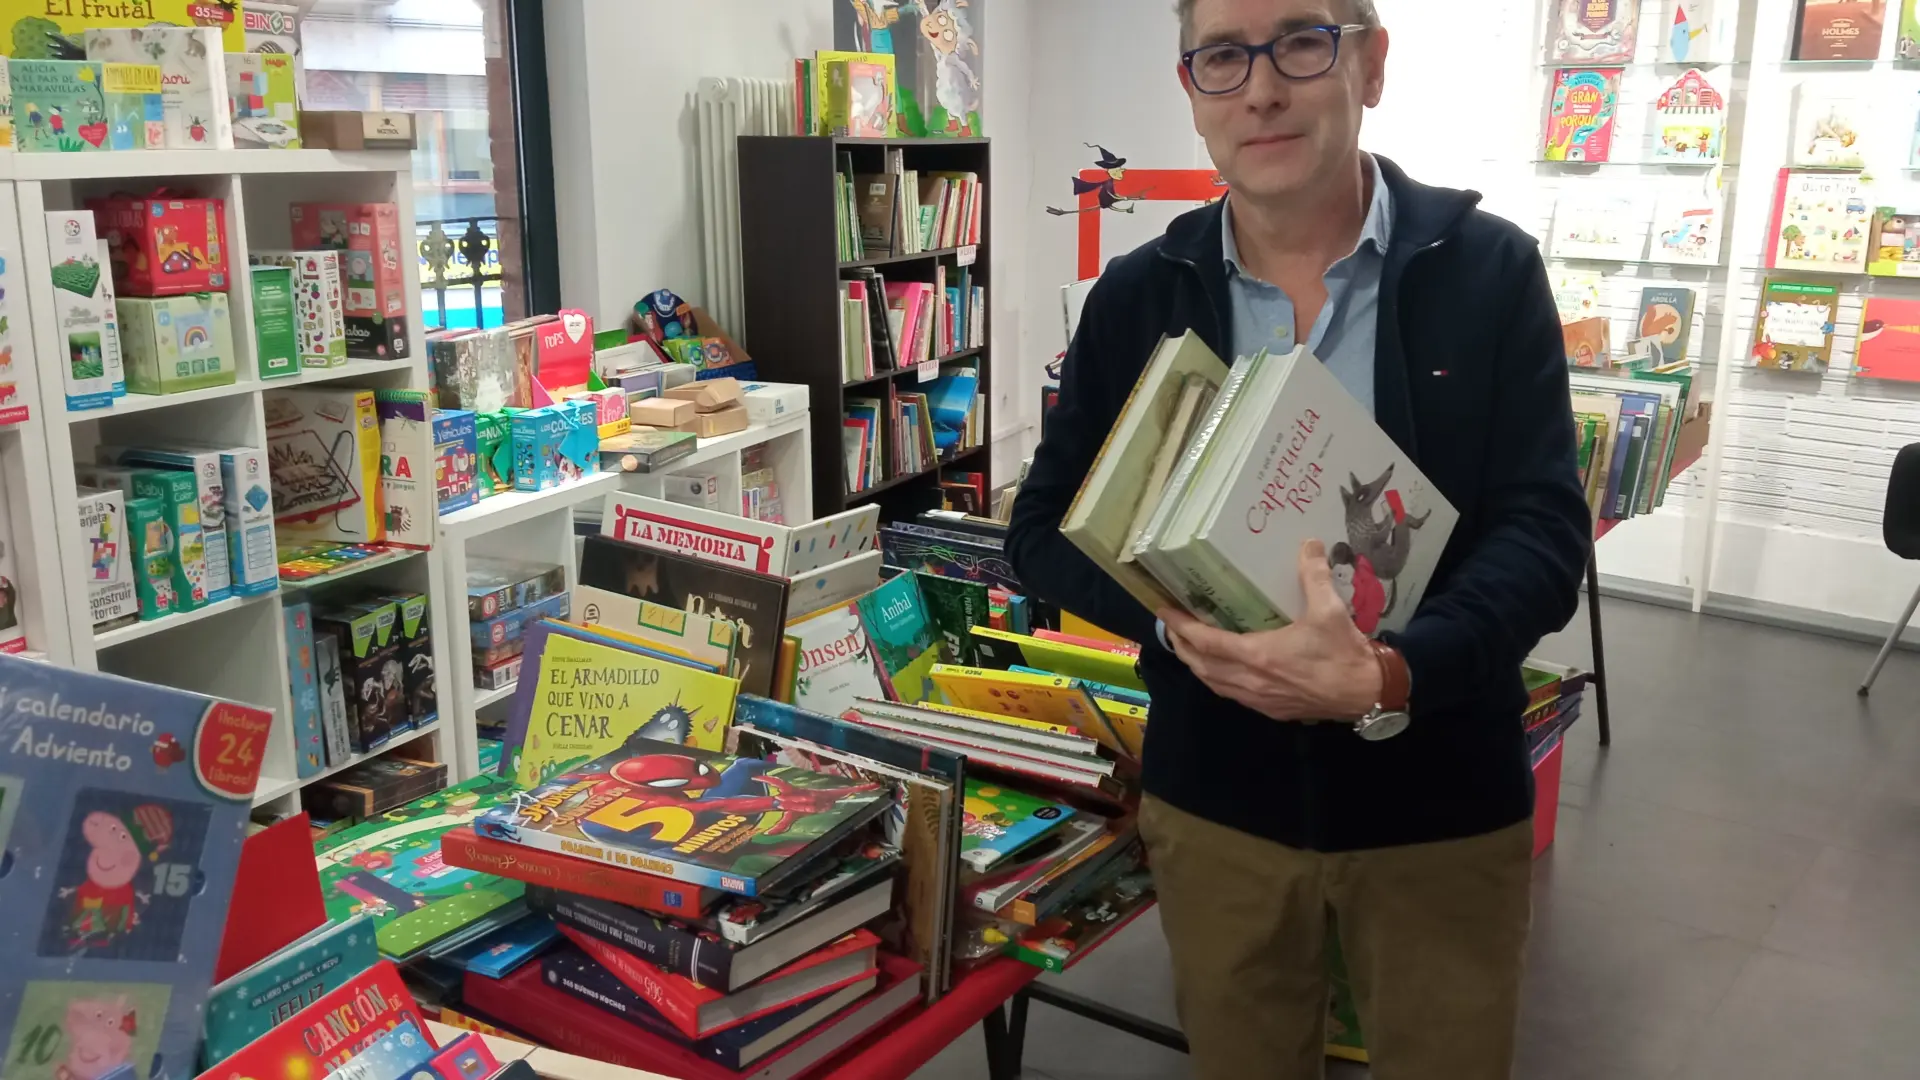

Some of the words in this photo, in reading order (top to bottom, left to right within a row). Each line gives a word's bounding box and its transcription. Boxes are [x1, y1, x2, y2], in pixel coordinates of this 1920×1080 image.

[195, 7, 209, 18] 35
[244, 11, 295, 34] BINGO
[1822, 27, 1859, 36] HOLMES
[22, 65, 56, 74] ALICIA
[18, 85, 86, 94] MARAVILLAS
[1571, 91, 1599, 104] GRAN
[1651, 296, 1677, 304] ARDILLA
[544, 332, 565, 348] POPS
[1246, 408, 1321, 534] Caperucita
[136, 481, 164, 499] Baby
[172, 481, 192, 492] Baby
[1285, 462, 1324, 514] Roja
[95, 501, 105, 513] la
[80, 513, 108, 528] arjeta
[631, 521, 653, 541] LA
[656, 527, 746, 562] MEMORIA
[551, 669, 567, 685] EL
[571, 667, 660, 689] ARMADILLO
[548, 691, 573, 707] QUE
[580, 692, 614, 710] VINO
[618, 693, 630, 711] A
[15, 693, 155, 737] calendario
[546, 712, 613, 739] CENAR
[11, 725, 132, 772] Adviento
[215, 733, 255, 767] 24
[586, 796, 695, 842] 5
[672, 814, 747, 854] MINUTOS
[152, 863, 191, 897] 15
[721, 876, 744, 892] MARVEL
[303, 983, 390, 1057] CANCIÓN
[17, 1023, 62, 1067] 10
